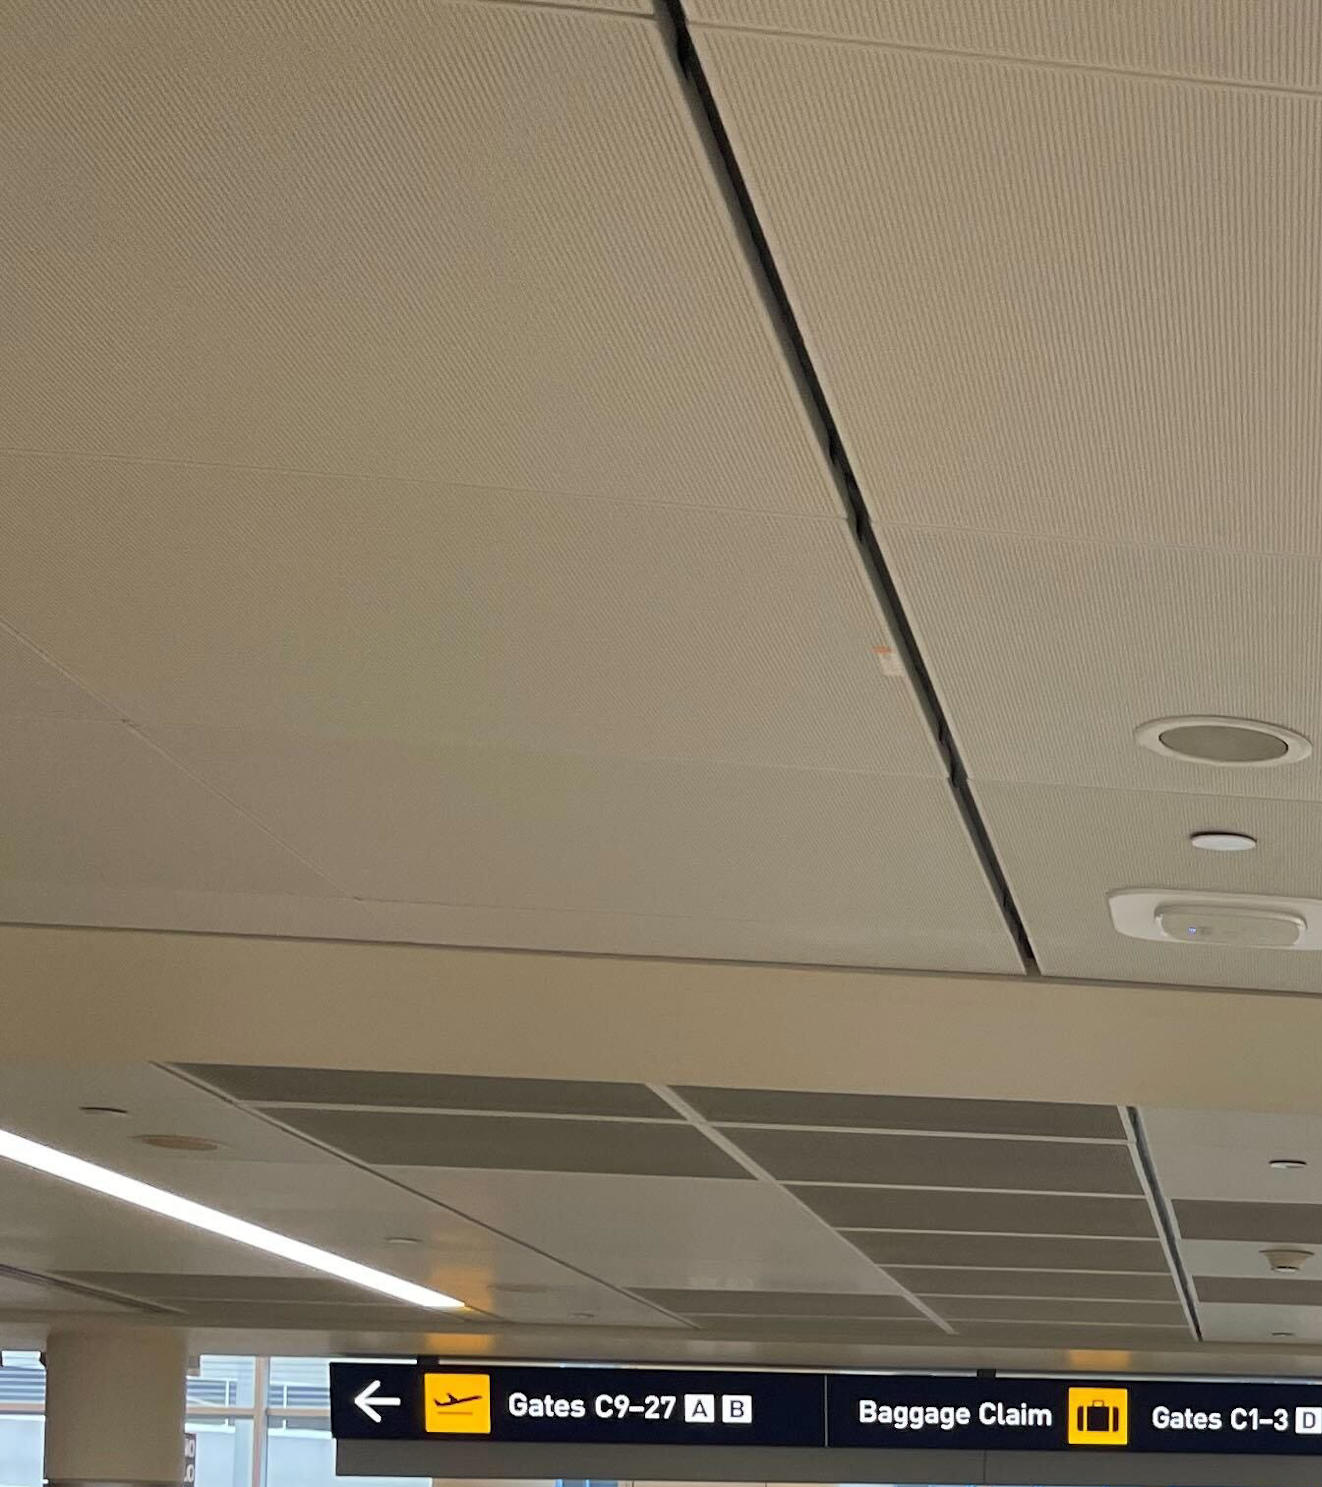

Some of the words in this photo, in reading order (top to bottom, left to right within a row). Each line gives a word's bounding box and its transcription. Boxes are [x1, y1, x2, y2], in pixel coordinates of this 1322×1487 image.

[508, 1392, 586, 1418] Gates
[594, 1393, 676, 1420] C9-27
[687, 1396, 711, 1420] A
[725, 1397, 749, 1421] B
[859, 1399, 970, 1430] Baggage
[978, 1401, 1053, 1427] Claim
[1152, 1405, 1223, 1430] Gates
[1230, 1407, 1289, 1431] C1-3
[1299, 1409, 1319, 1432] D
